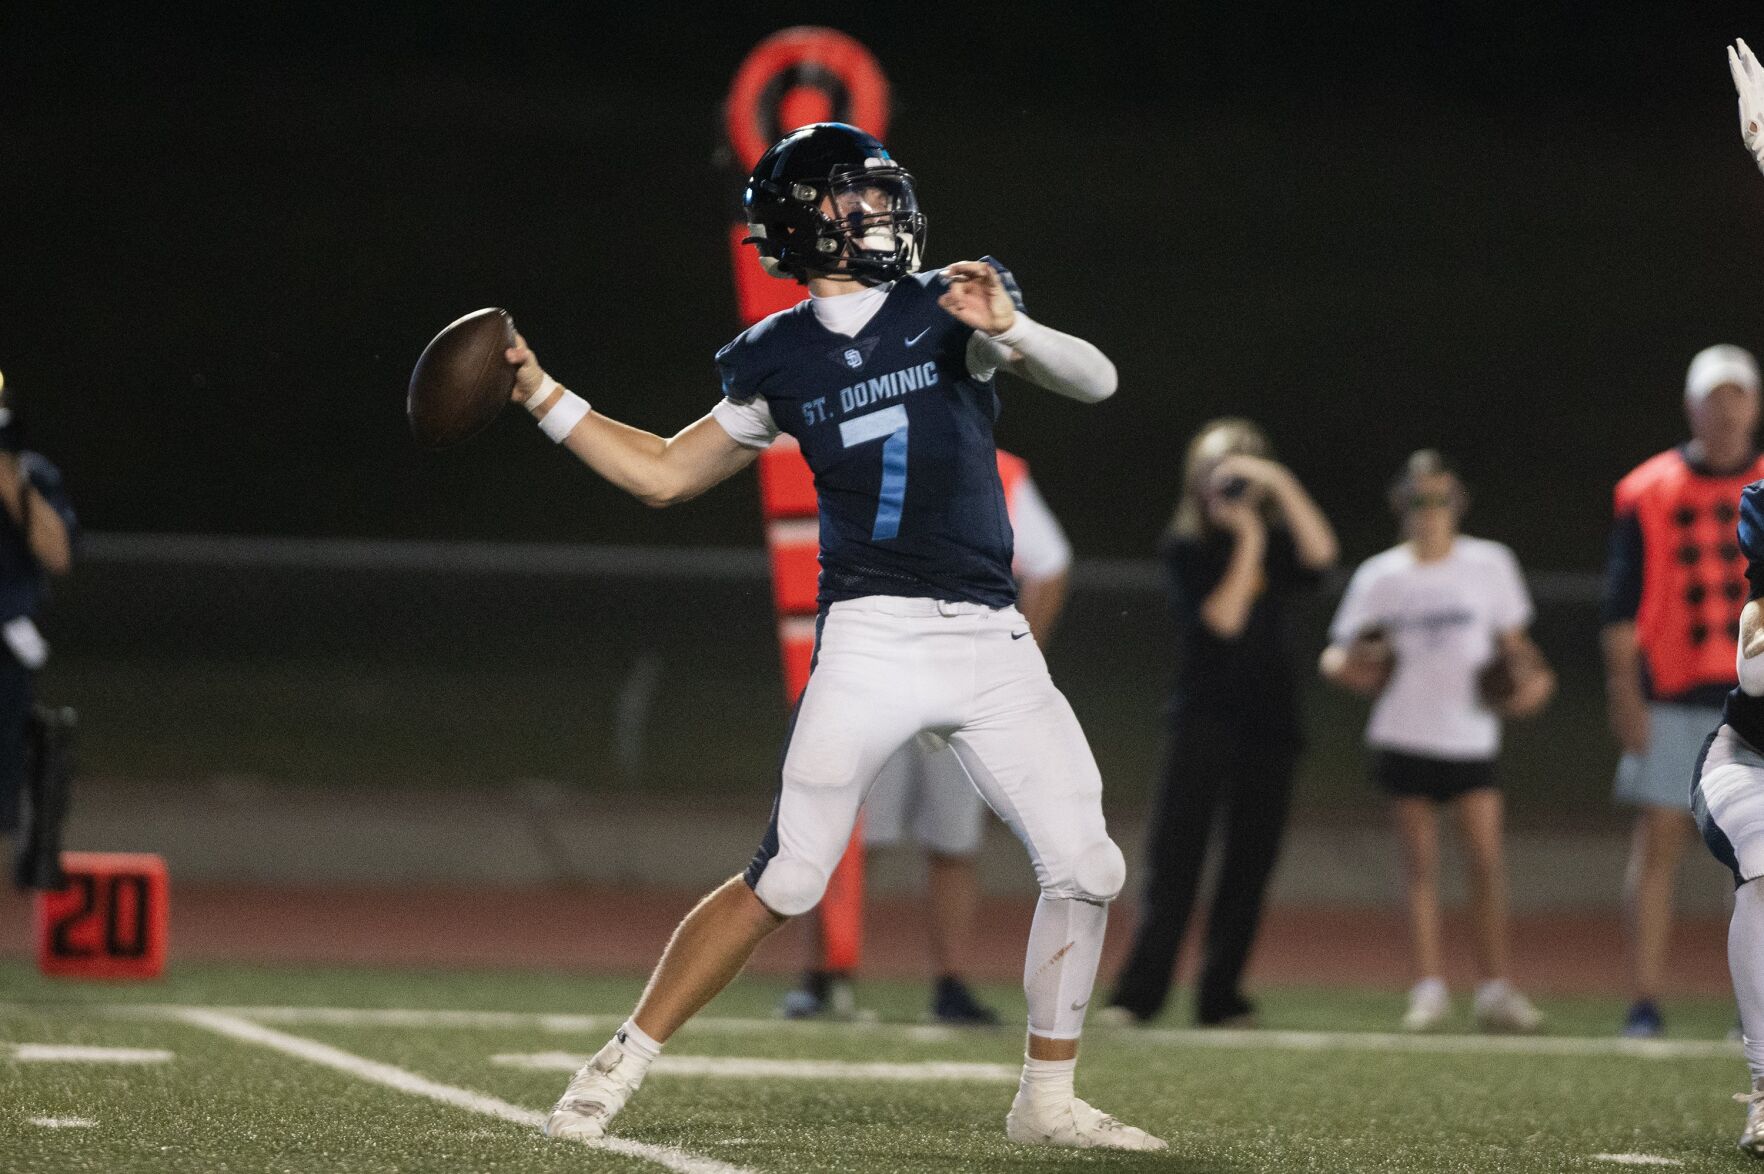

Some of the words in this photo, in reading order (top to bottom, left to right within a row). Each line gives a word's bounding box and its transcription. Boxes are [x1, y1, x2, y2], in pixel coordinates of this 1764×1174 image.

[801, 397, 834, 426] ST.
[839, 361, 938, 413] DOMINIC
[839, 404, 909, 541] 7
[53, 873, 147, 959] 20
